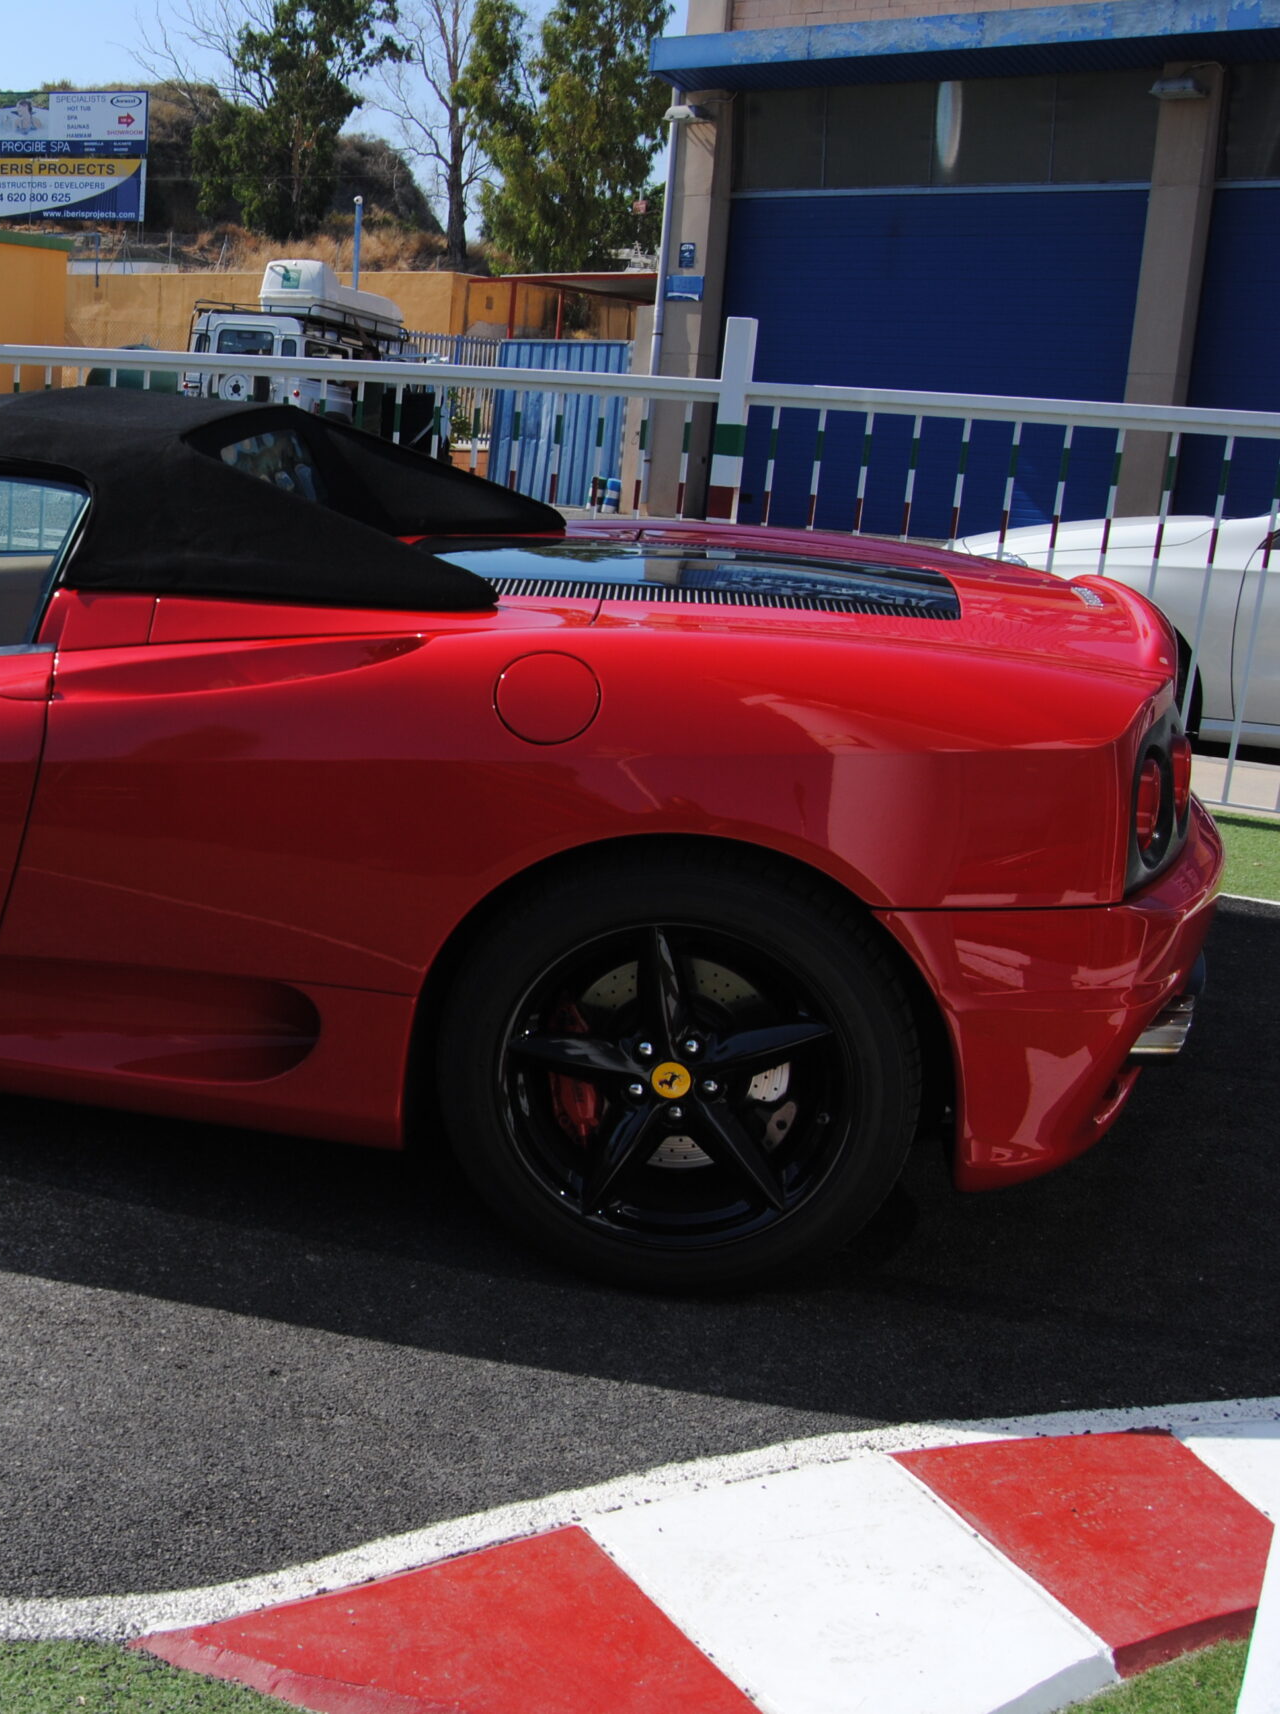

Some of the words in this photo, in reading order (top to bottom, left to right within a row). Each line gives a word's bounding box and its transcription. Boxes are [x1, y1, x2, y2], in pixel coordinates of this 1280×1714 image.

[55, 95, 106, 104] SPECIALISTS
[1, 141, 47, 153] PROGIBE
[50, 141, 70, 153] SPA
[38, 163, 116, 175] PROJECTS
[54, 181, 105, 190] DEVELOPERS
[7, 192, 26, 203] 620
[29, 192, 49, 203] 800
[51, 192, 71, 203] 625
[42, 209, 136, 220] www.iberisprojects.com
